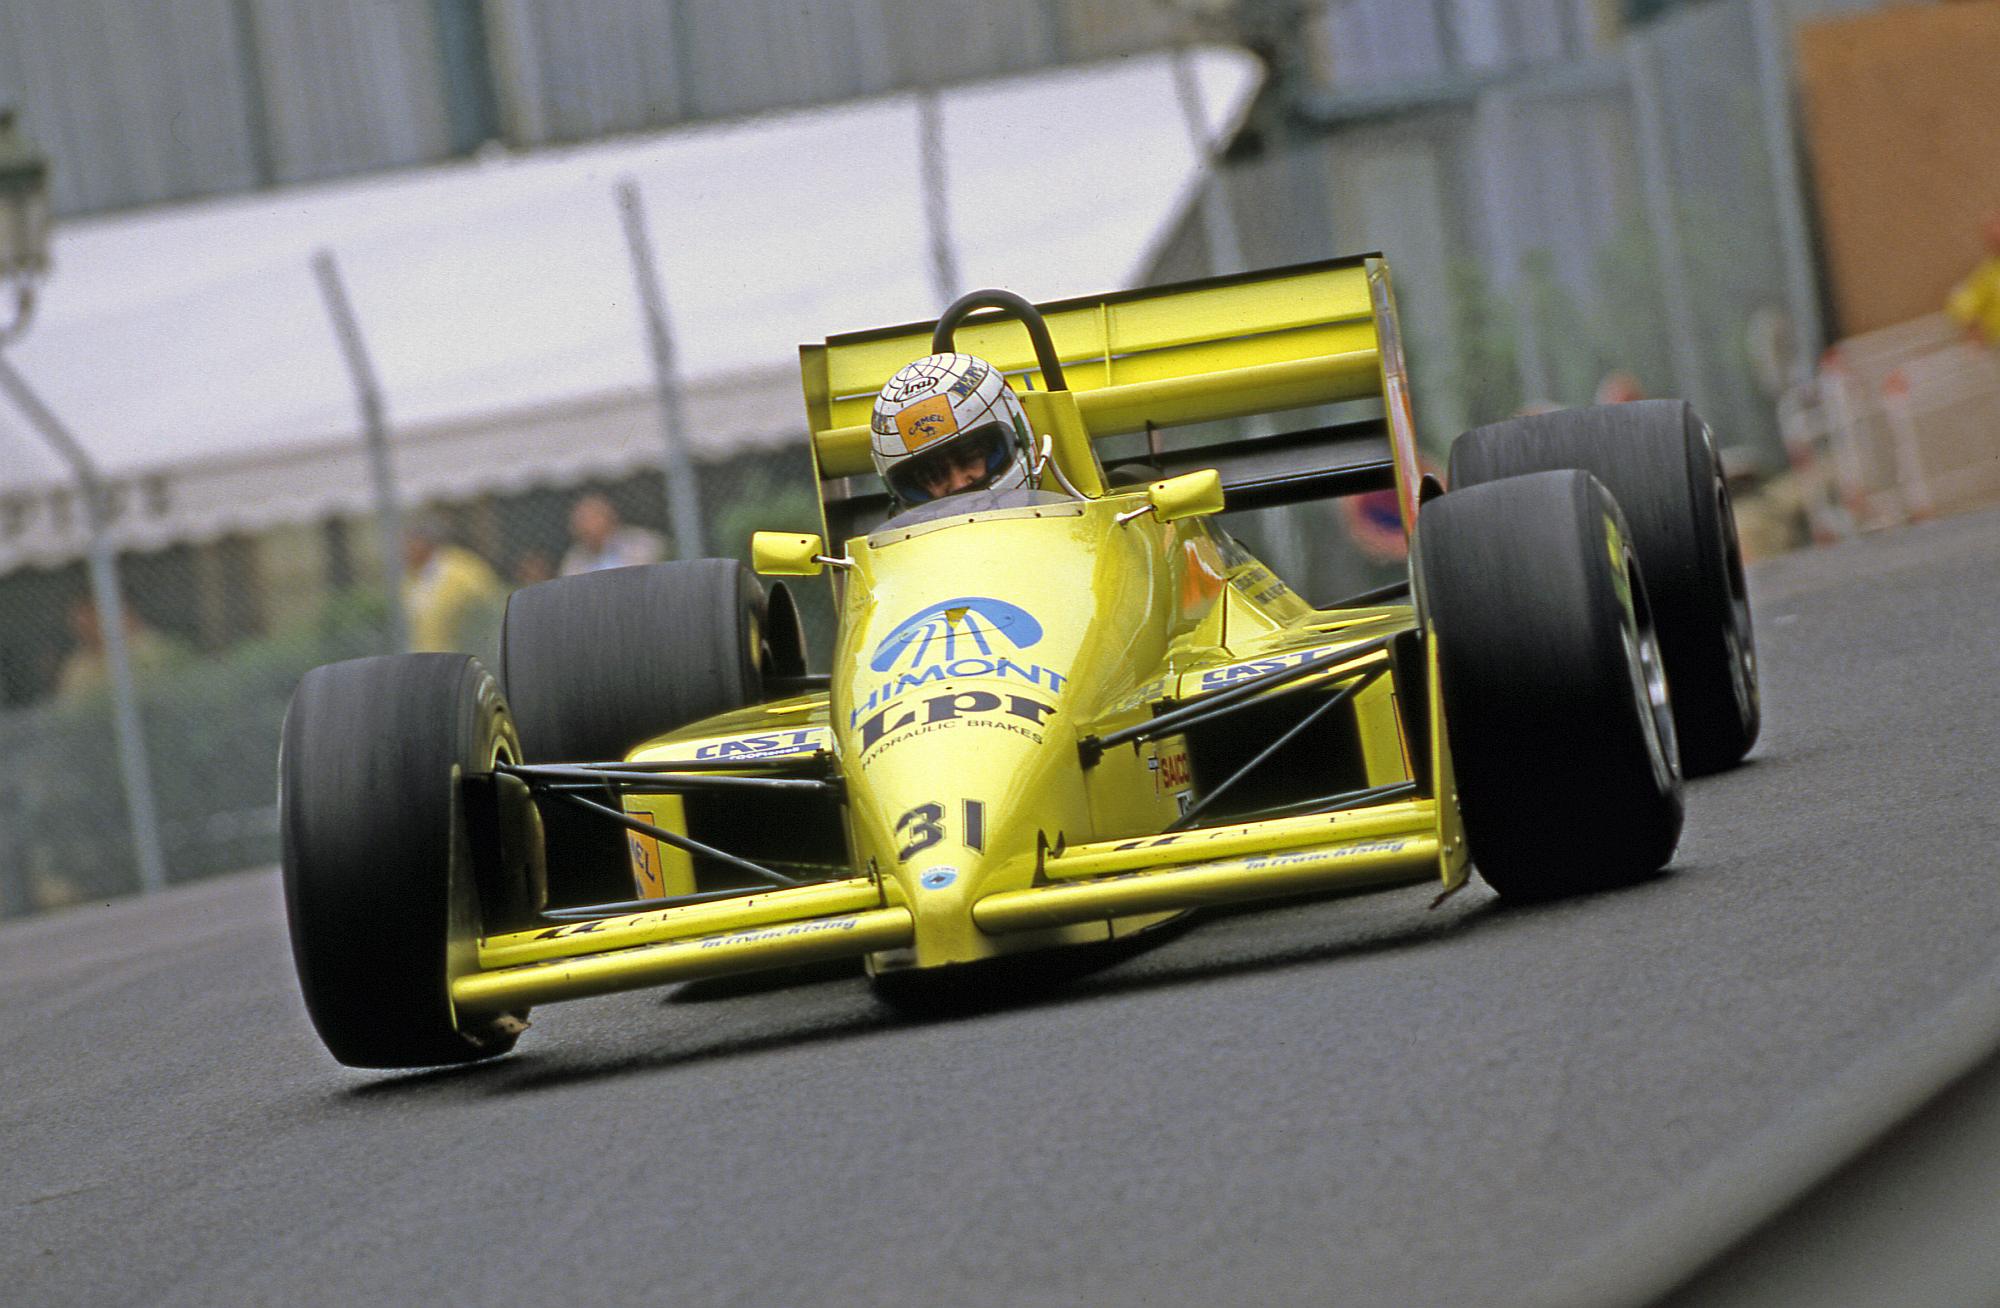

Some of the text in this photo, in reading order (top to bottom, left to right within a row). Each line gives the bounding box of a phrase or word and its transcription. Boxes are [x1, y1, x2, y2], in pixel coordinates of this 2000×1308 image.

[902, 377, 931, 396] Arai
[908, 414, 944, 435] CAMEL
[850, 657, 1067, 729] HIMONT
[696, 727, 824, 759] CAST
[862, 720, 1042, 770] HYDRAULIC BRAKES
[895, 798, 986, 864] 31
